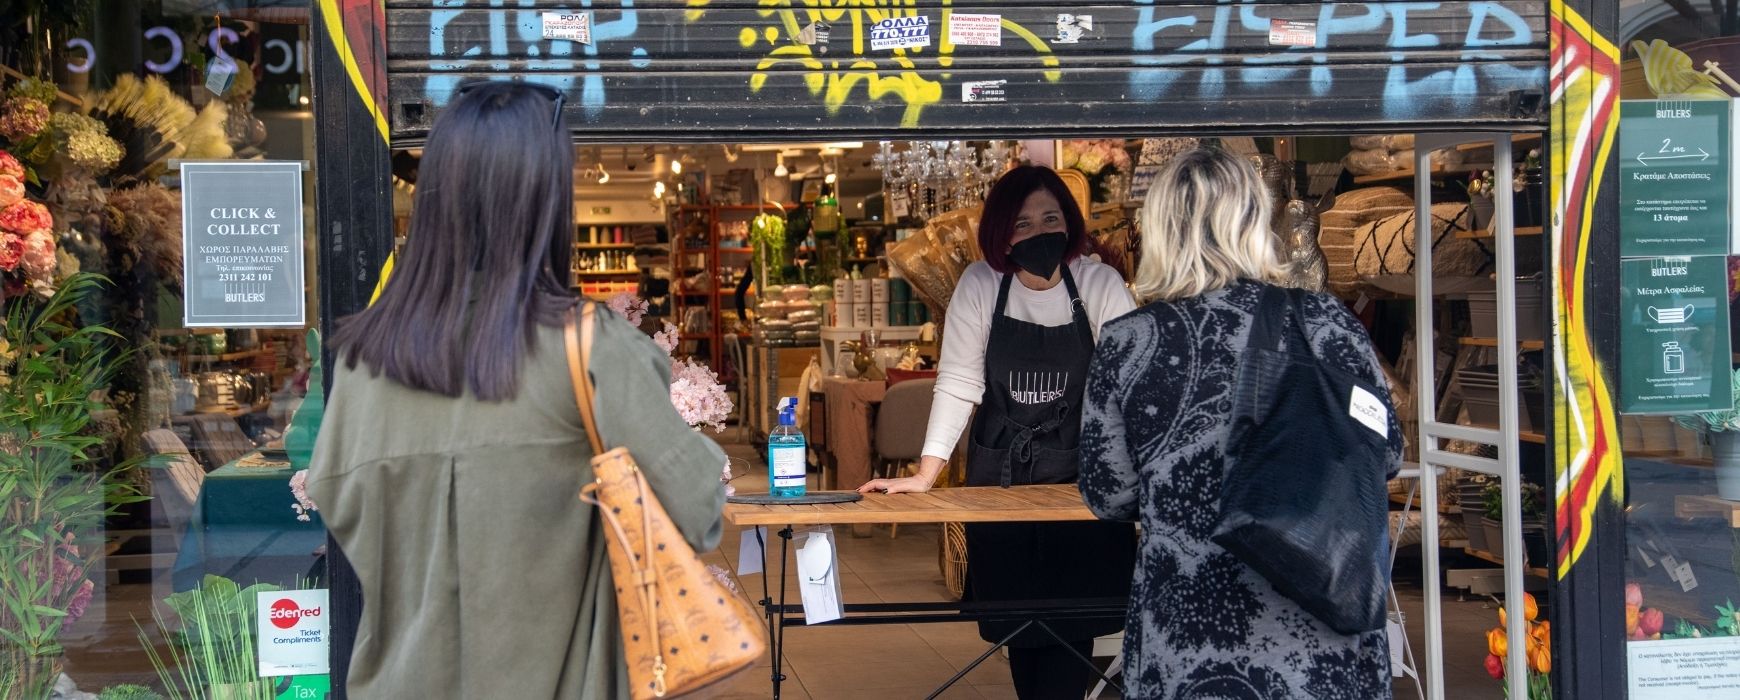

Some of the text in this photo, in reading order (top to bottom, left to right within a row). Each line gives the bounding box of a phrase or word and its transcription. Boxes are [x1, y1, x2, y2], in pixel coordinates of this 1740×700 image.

[1656, 109, 1691, 119] BUTLERS
[1659, 138, 1671, 153] 2
[1633, 171, 1711, 181] Κρατάμε Αποστάσεις
[210, 207, 276, 219] CLICK &
[1653, 214, 1688, 222] 13 άτομα
[207, 224, 281, 235] COLLECT
[233, 245, 289, 253] ΠΑΡΑΛΑΒΗΣ
[206, 255, 283, 263] ΕΜΠΟΡΕΥΜΑΤΩΝ
[232, 264, 274, 272] επικοινωνίας
[1651, 267, 1688, 277] BUTLERS
[219, 273, 272, 281] 2311 242 101
[1637, 285, 1704, 296] Μέτρα Ασφαλείας
[225, 293, 265, 302] BUTLERS
[1011, 389, 1063, 404] BUTLERS
[270, 606, 320, 618] Edenred
[300, 629, 320, 637] Ticket
[273, 636, 321, 644] Compliments
[293, 685, 317, 699] Tax
